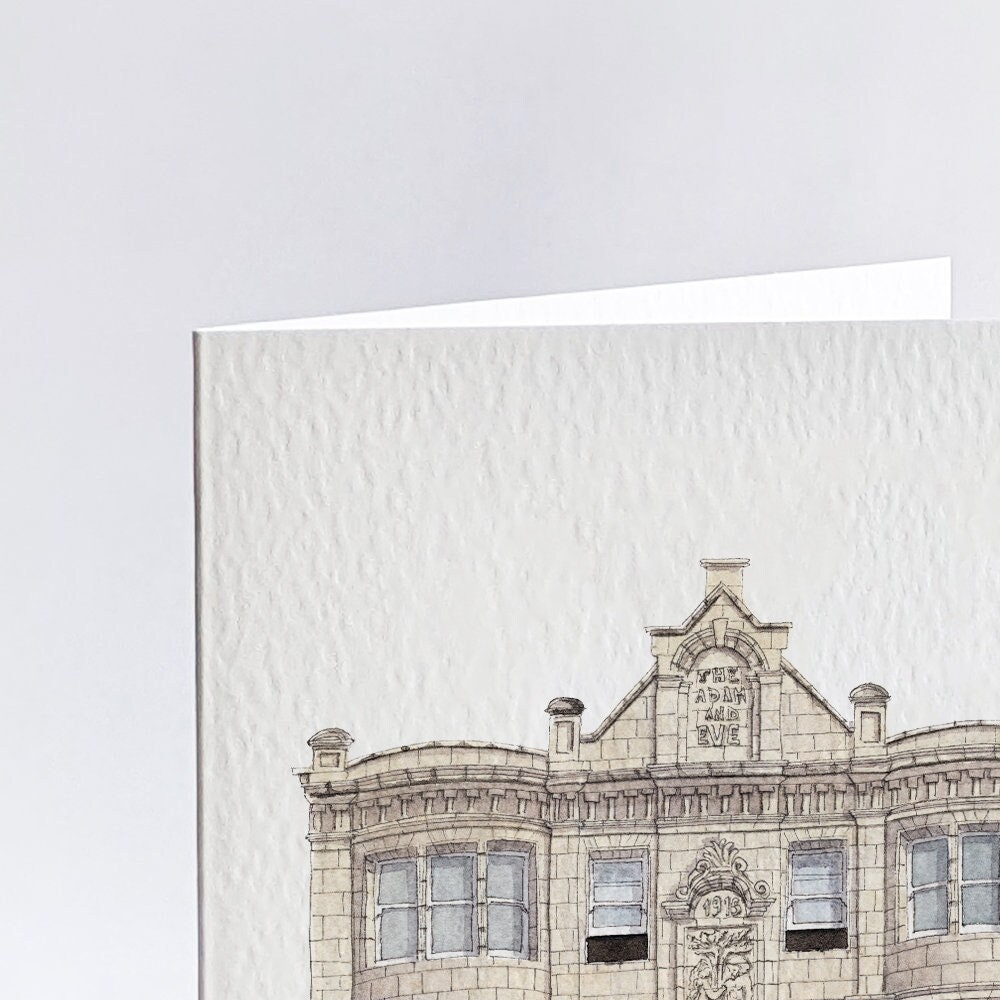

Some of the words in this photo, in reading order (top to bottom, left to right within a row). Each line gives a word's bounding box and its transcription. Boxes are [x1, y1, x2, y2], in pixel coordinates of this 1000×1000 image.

[697, 667, 739, 684] THE
[695, 685, 747, 705] ADAM
[704, 705, 740, 721] AND
[697, 723, 740, 746] EVE
